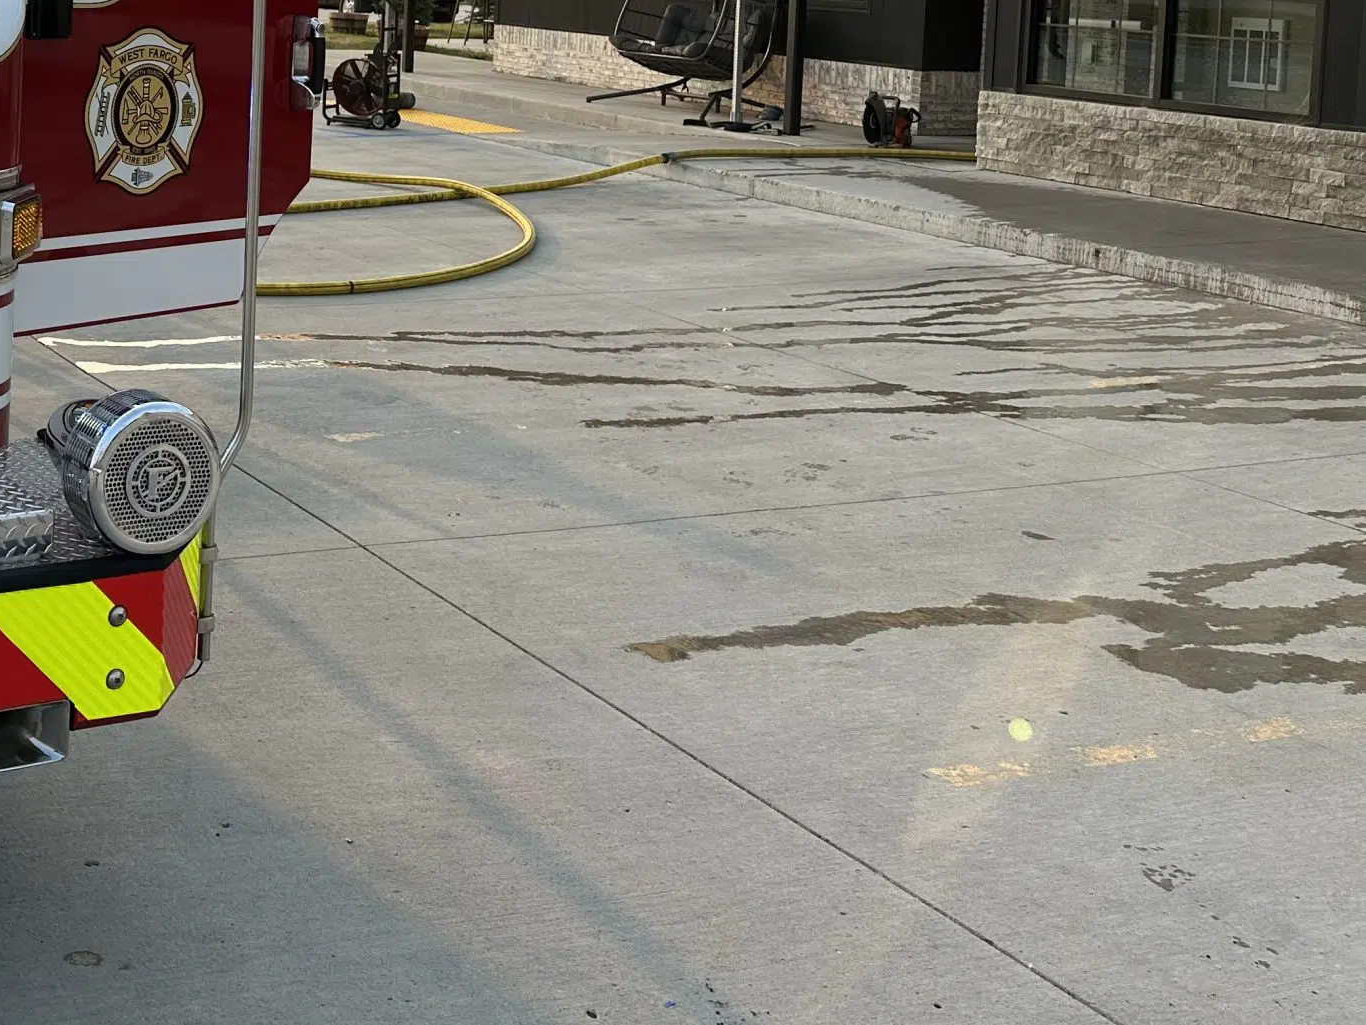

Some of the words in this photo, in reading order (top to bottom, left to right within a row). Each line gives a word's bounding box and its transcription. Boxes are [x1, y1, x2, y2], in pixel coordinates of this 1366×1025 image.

[118, 48, 145, 64] WEST
[148, 48, 178, 65] FARGO
[125, 154, 141, 164] FIRE
